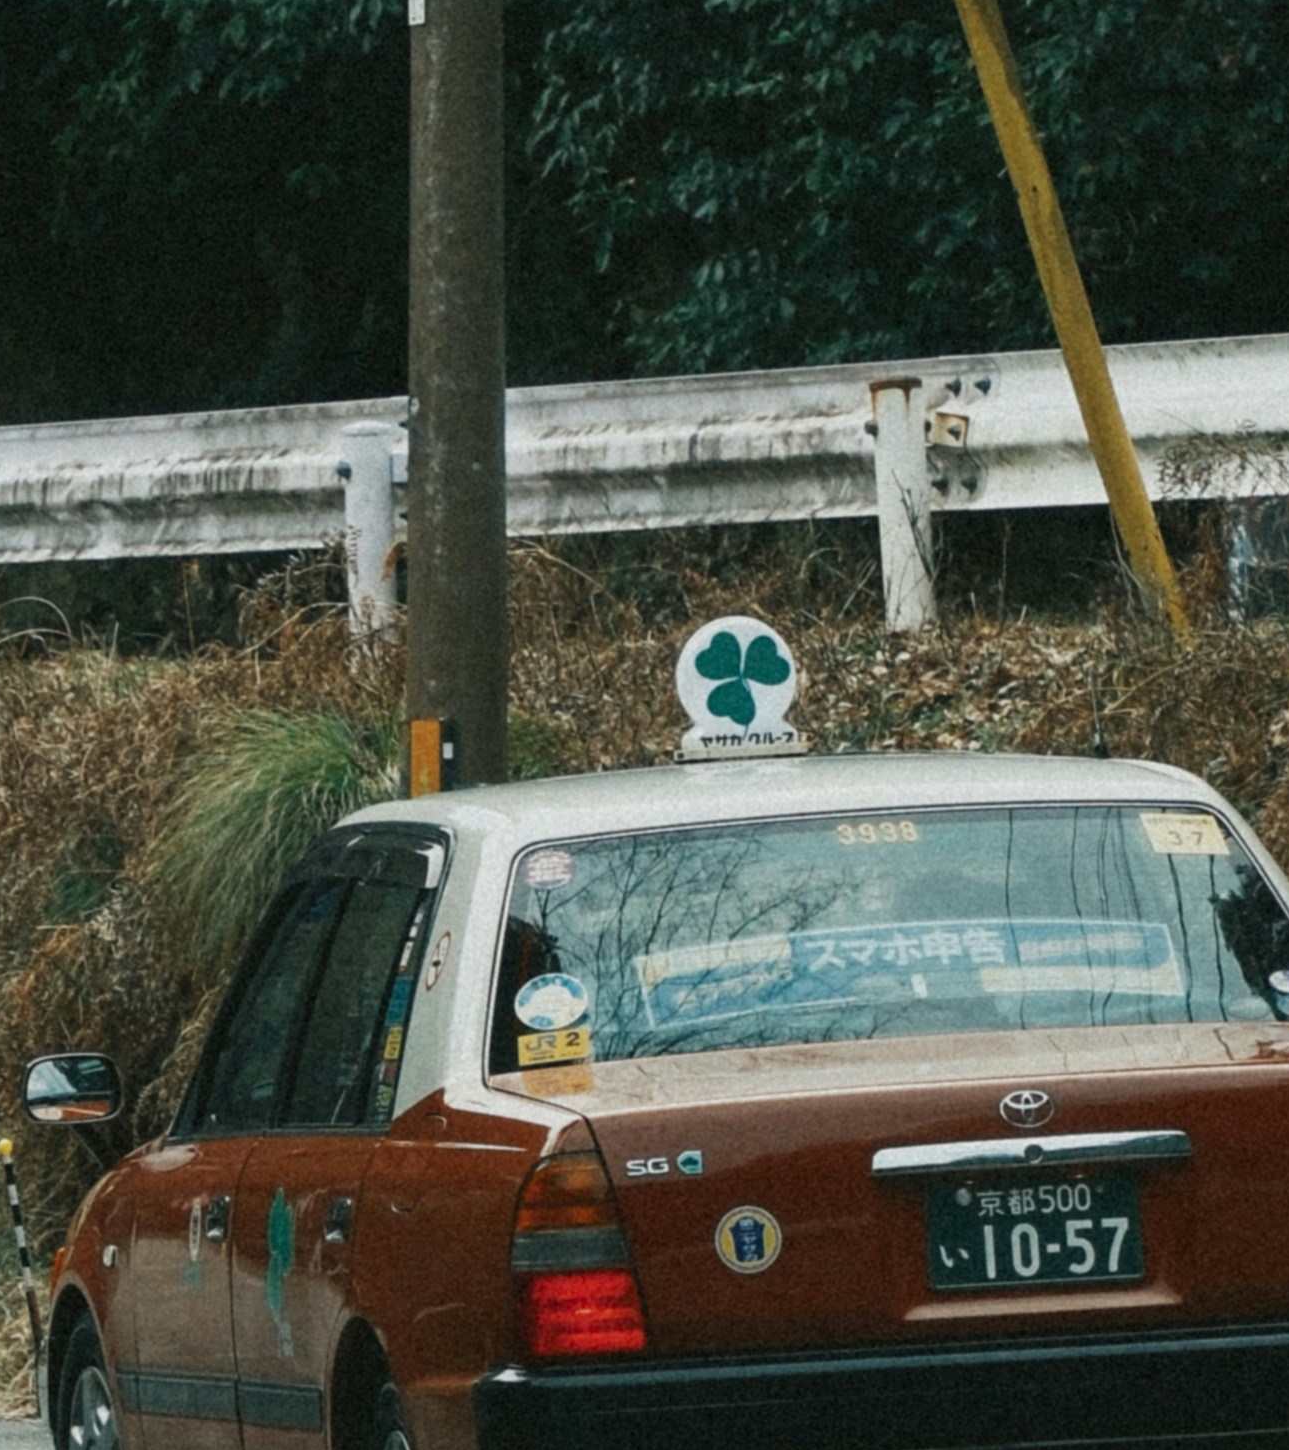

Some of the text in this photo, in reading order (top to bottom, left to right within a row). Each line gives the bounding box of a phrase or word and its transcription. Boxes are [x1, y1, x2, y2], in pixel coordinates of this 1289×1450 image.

[565, 1031, 581, 1047] 2
[626, 1157, 669, 1176] SG
[976, 1183, 1091, 1217] 京都500
[938, 1216, 1129, 1279] い 10-57
